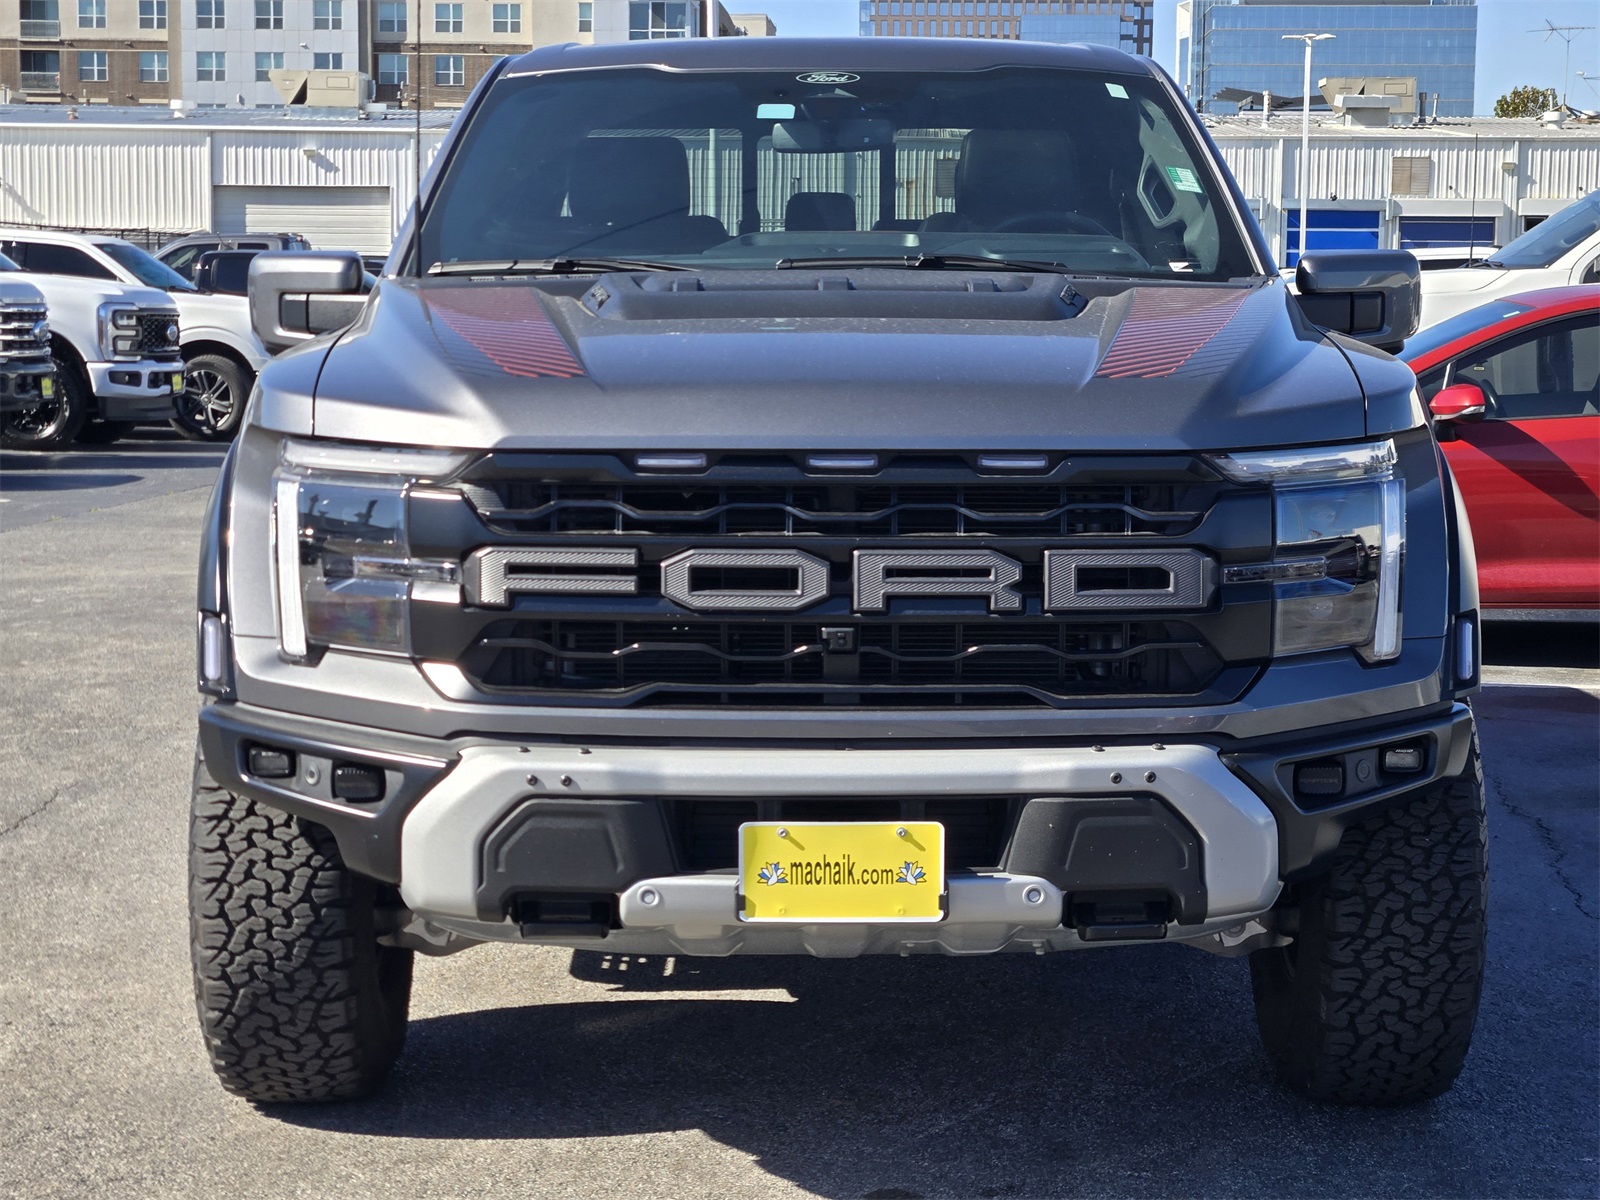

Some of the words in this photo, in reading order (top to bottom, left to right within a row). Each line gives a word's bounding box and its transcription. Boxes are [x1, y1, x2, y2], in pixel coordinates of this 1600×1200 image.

[807, 73, 848, 82] Ford
[475, 547, 1216, 612] FORD
[789, 854, 895, 886] machaik.com
